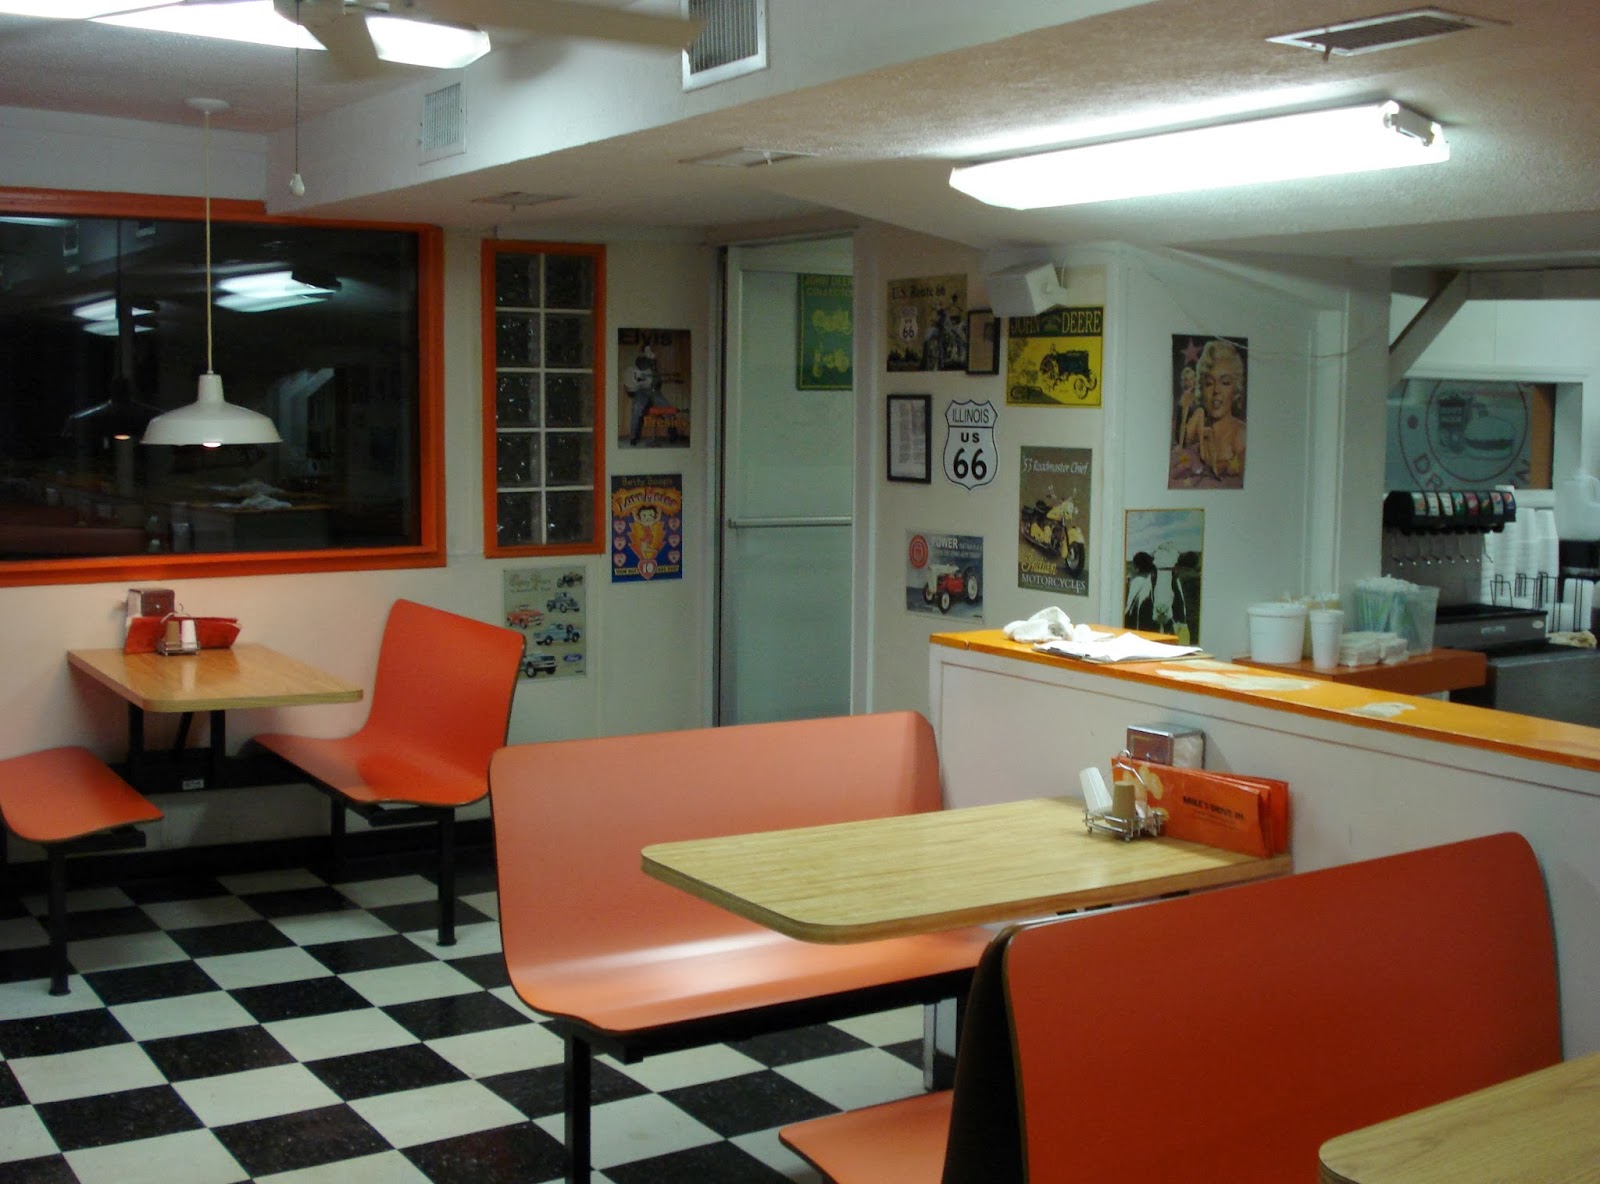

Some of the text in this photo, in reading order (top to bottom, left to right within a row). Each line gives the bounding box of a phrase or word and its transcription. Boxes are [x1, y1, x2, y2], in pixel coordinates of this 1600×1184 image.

[1010, 311, 1101, 334] JOHN DEERE
[902, 326, 915, 339] 66
[643, 416, 690, 429] Presley
[952, 408, 989, 423] ILLINOIS
[961, 432, 980, 443] US
[953, 448, 987, 479] 66
[931, 536, 959, 549] POWER
[1021, 573, 1086, 593] MOTORCYCLES
